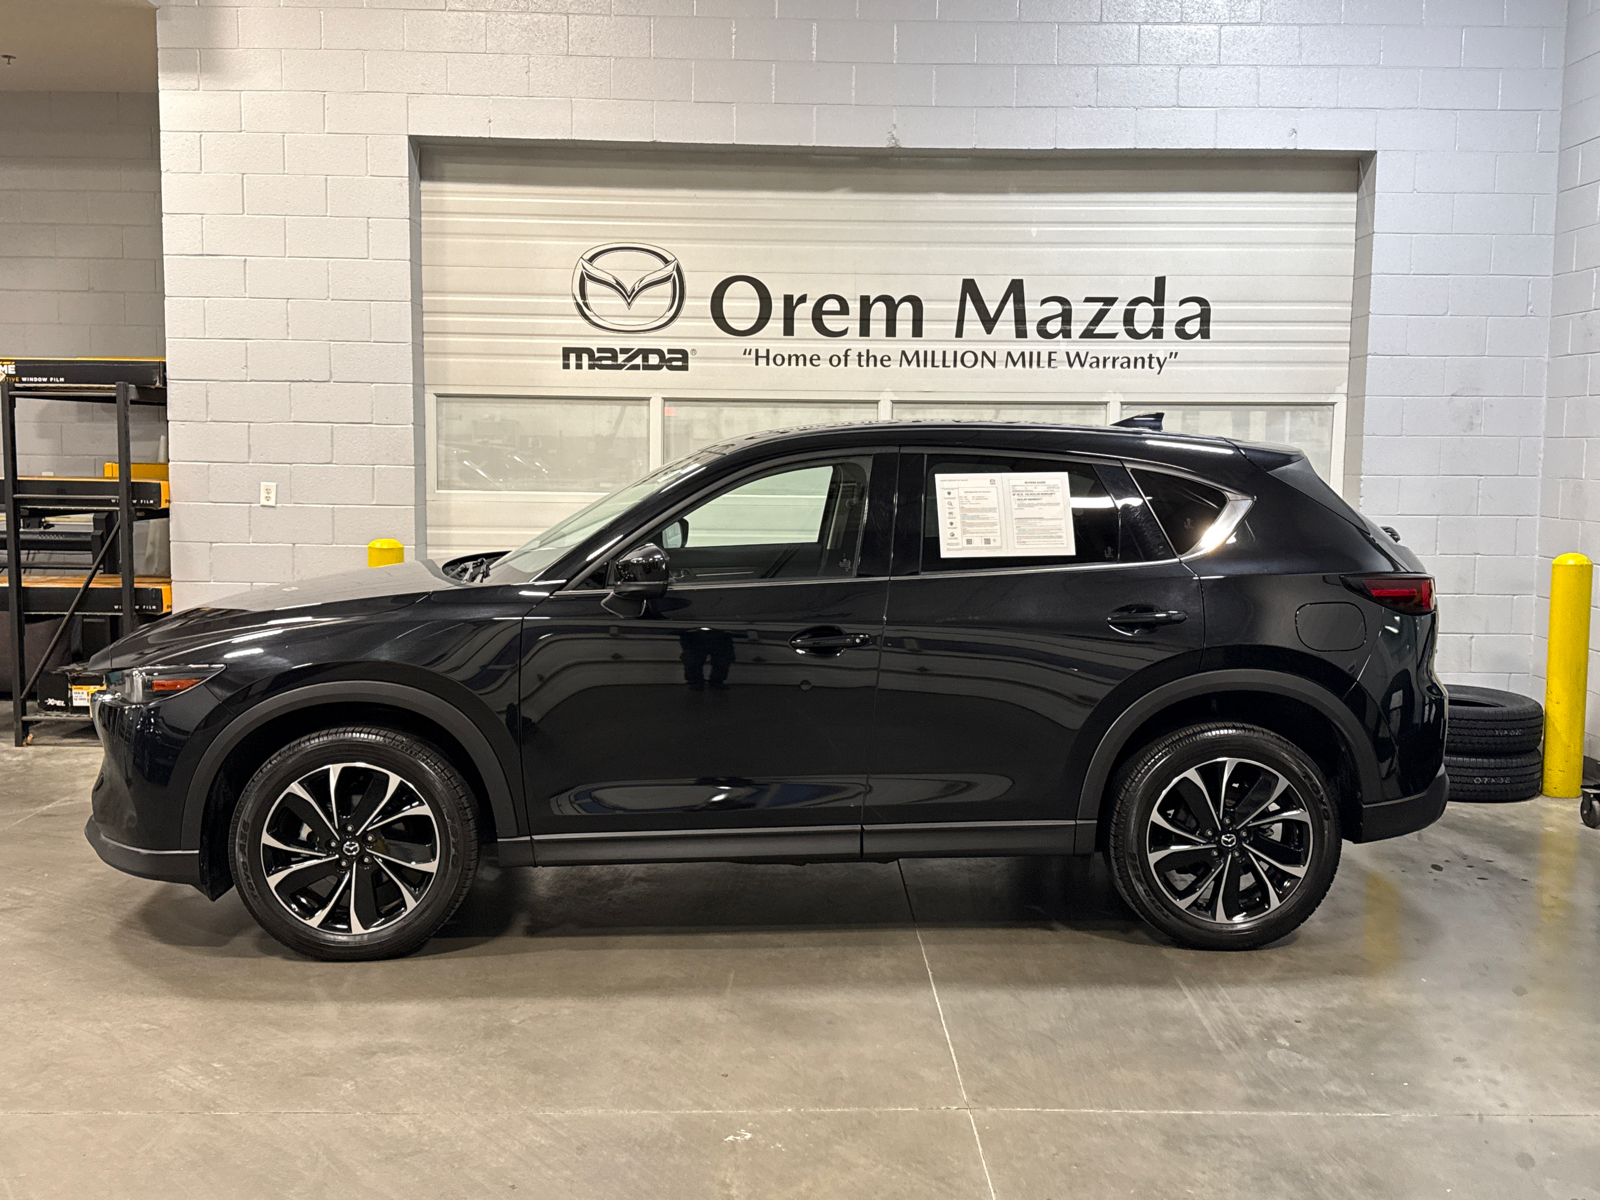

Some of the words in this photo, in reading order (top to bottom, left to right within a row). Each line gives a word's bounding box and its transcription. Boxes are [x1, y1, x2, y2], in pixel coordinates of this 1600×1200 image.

[710, 275, 924, 338] Orem
[954, 275, 1212, 340] Mazda
[828, 348, 852, 368] of
[856, 348, 892, 368] the
[899, 350, 997, 369] MILLION
[1004, 351, 1058, 369] MILE
